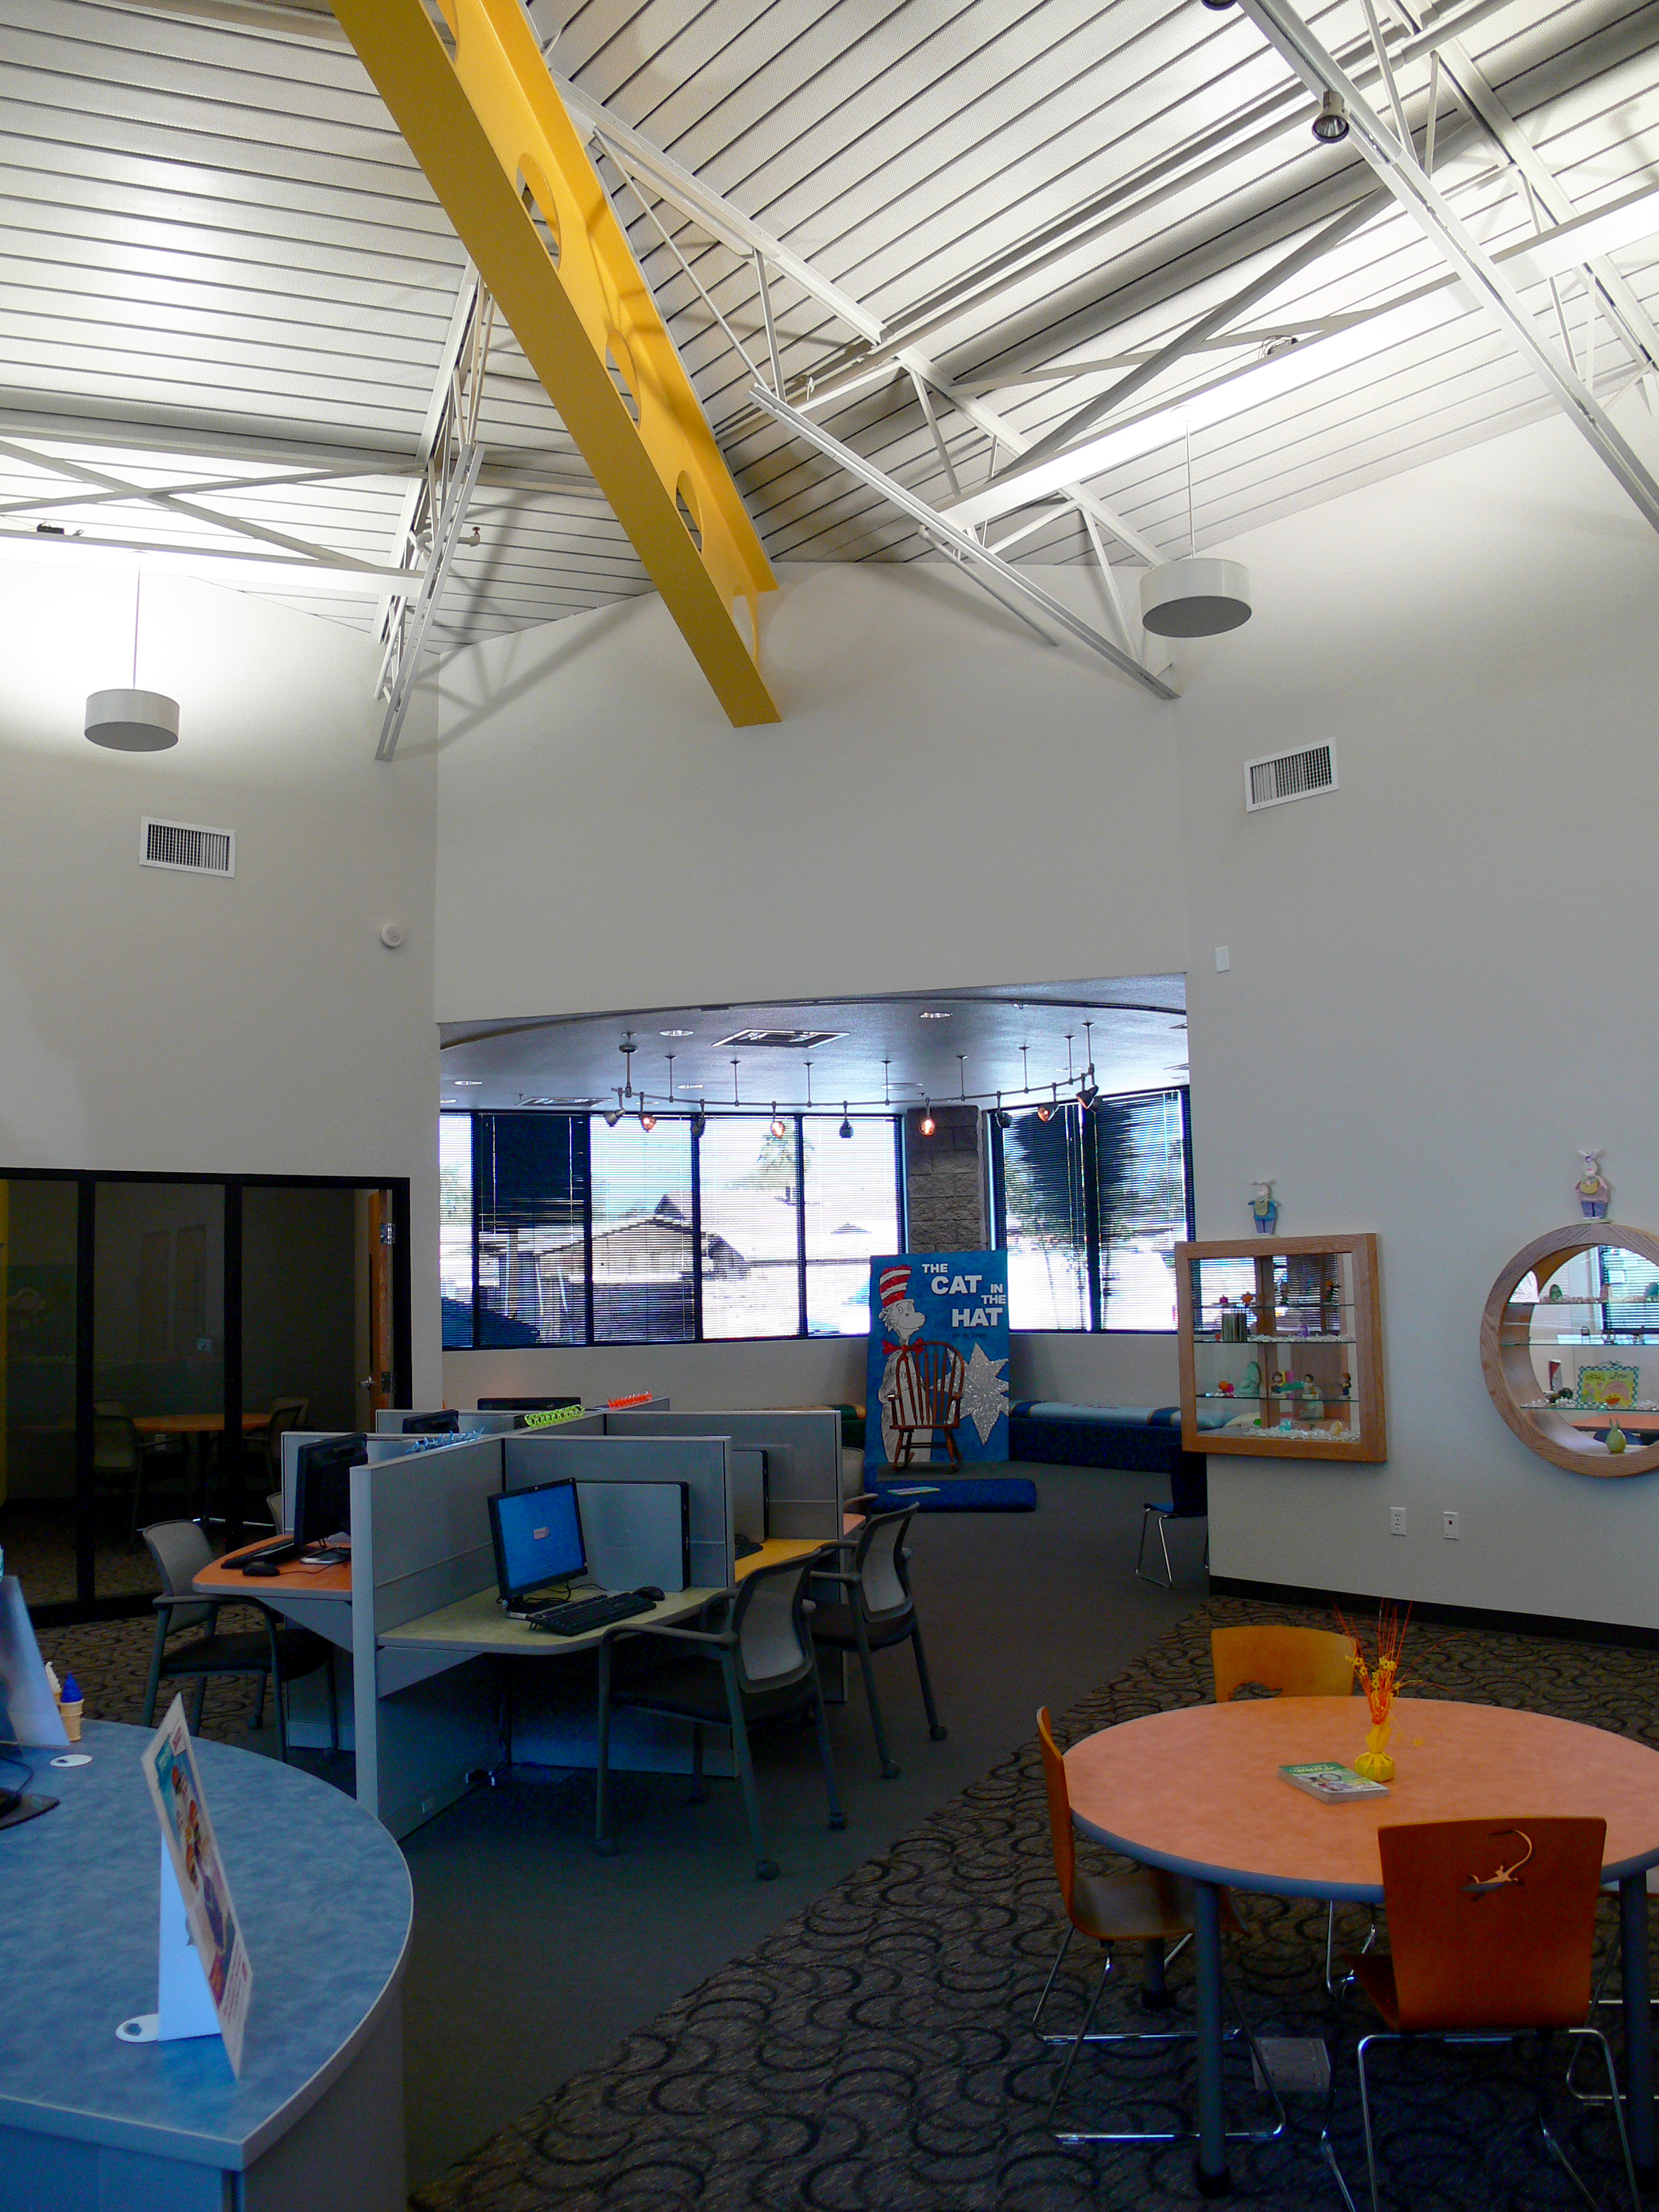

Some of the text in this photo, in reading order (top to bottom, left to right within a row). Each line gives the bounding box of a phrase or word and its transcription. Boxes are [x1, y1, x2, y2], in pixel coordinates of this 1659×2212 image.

[922, 1263, 948, 1273] THE
[931, 1275, 982, 1294] CAT
[990, 1284, 1003, 1294] IN
[981, 1294, 1006, 1305] THE
[952, 1307, 1002, 1327] HAT
